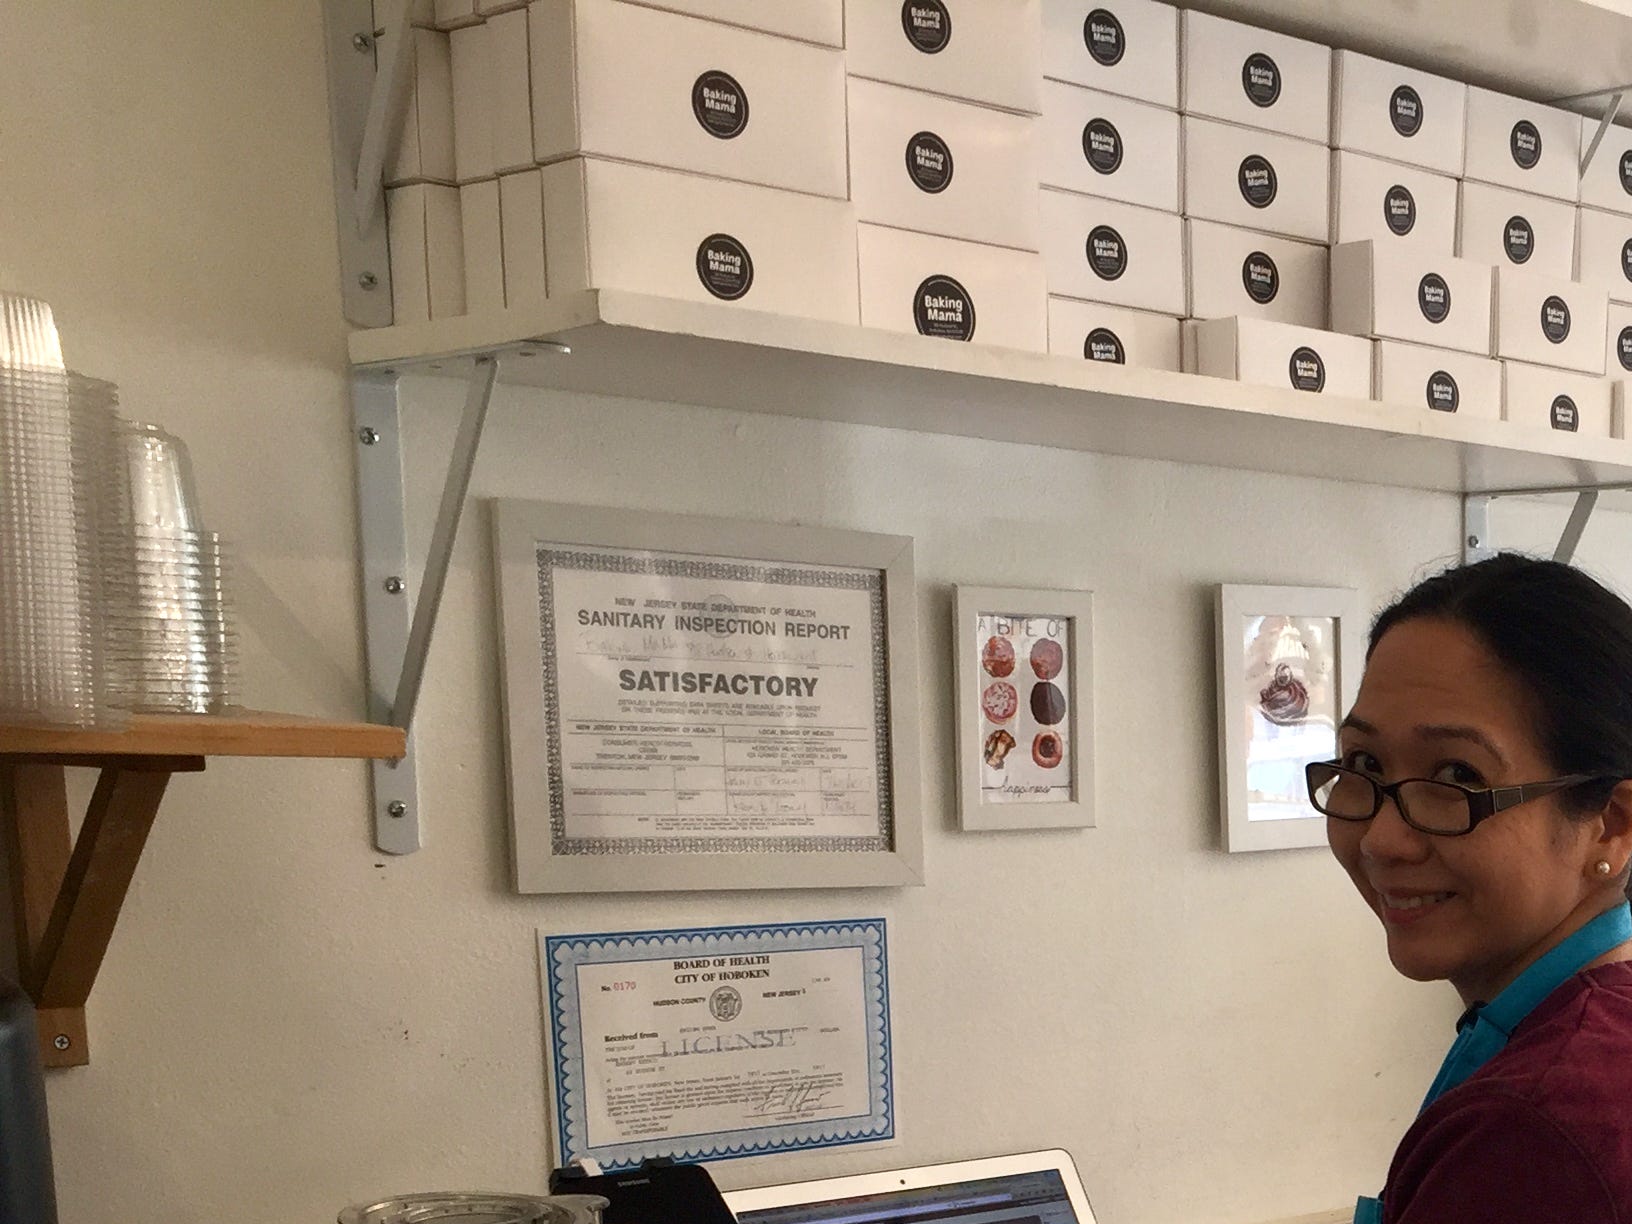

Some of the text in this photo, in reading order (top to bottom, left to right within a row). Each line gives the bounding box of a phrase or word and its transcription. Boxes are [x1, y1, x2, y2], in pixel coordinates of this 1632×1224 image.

[911, 7, 940, 22] Baking
[913, 17, 940, 29] Mama
[1091, 23, 1116, 37] Baking
[1093, 32, 1116, 43] Mama
[1250, 66, 1273, 80] Baking
[1251, 75, 1272, 86] Mama
[703, 88, 737, 104] Baking
[705, 98, 735, 113] Mama
[1090, 132, 1114, 146] Baking
[1092, 141, 1114, 152] Mama
[915, 146, 943, 164] Baking
[917, 156, 942, 170] Mama
[1245, 168, 1268, 180] Baking
[1248, 177, 1268, 186] Mama
[1094, 239, 1118, 251] Baking
[708, 250, 741, 266] Baking
[1096, 248, 1118, 258] Mama
[710, 261, 740, 274] Mama
[1250, 263, 1271, 277] Baking
[1251, 272, 1270, 283] Mama
[925, 295, 962, 312] Baking
[928, 309, 962, 322] Mama
[1091, 343, 1116, 354] Baking
[1093, 351, 1116, 360] Mama
[1296, 360, 1317, 372] Baking
[1297, 368, 1317, 378] Mama
[615, 598, 816, 617] NEW JERSEY STATE DEPARTMENT OF HEALTH
[578, 609, 850, 639] SANITARY INSPECTION REPORT
[998, 618, 1036, 637] BITE
[1046, 620, 1063, 637] OF
[619, 669, 818, 697] SATISFACTORY
[674, 955, 770, 970] BOARD OF HEALTH
[674, 969, 770, 984] CITY OF HOBOKEN
[604, 1033, 638, 1042] Received
[662, 1030, 796, 1057] LICENSE
